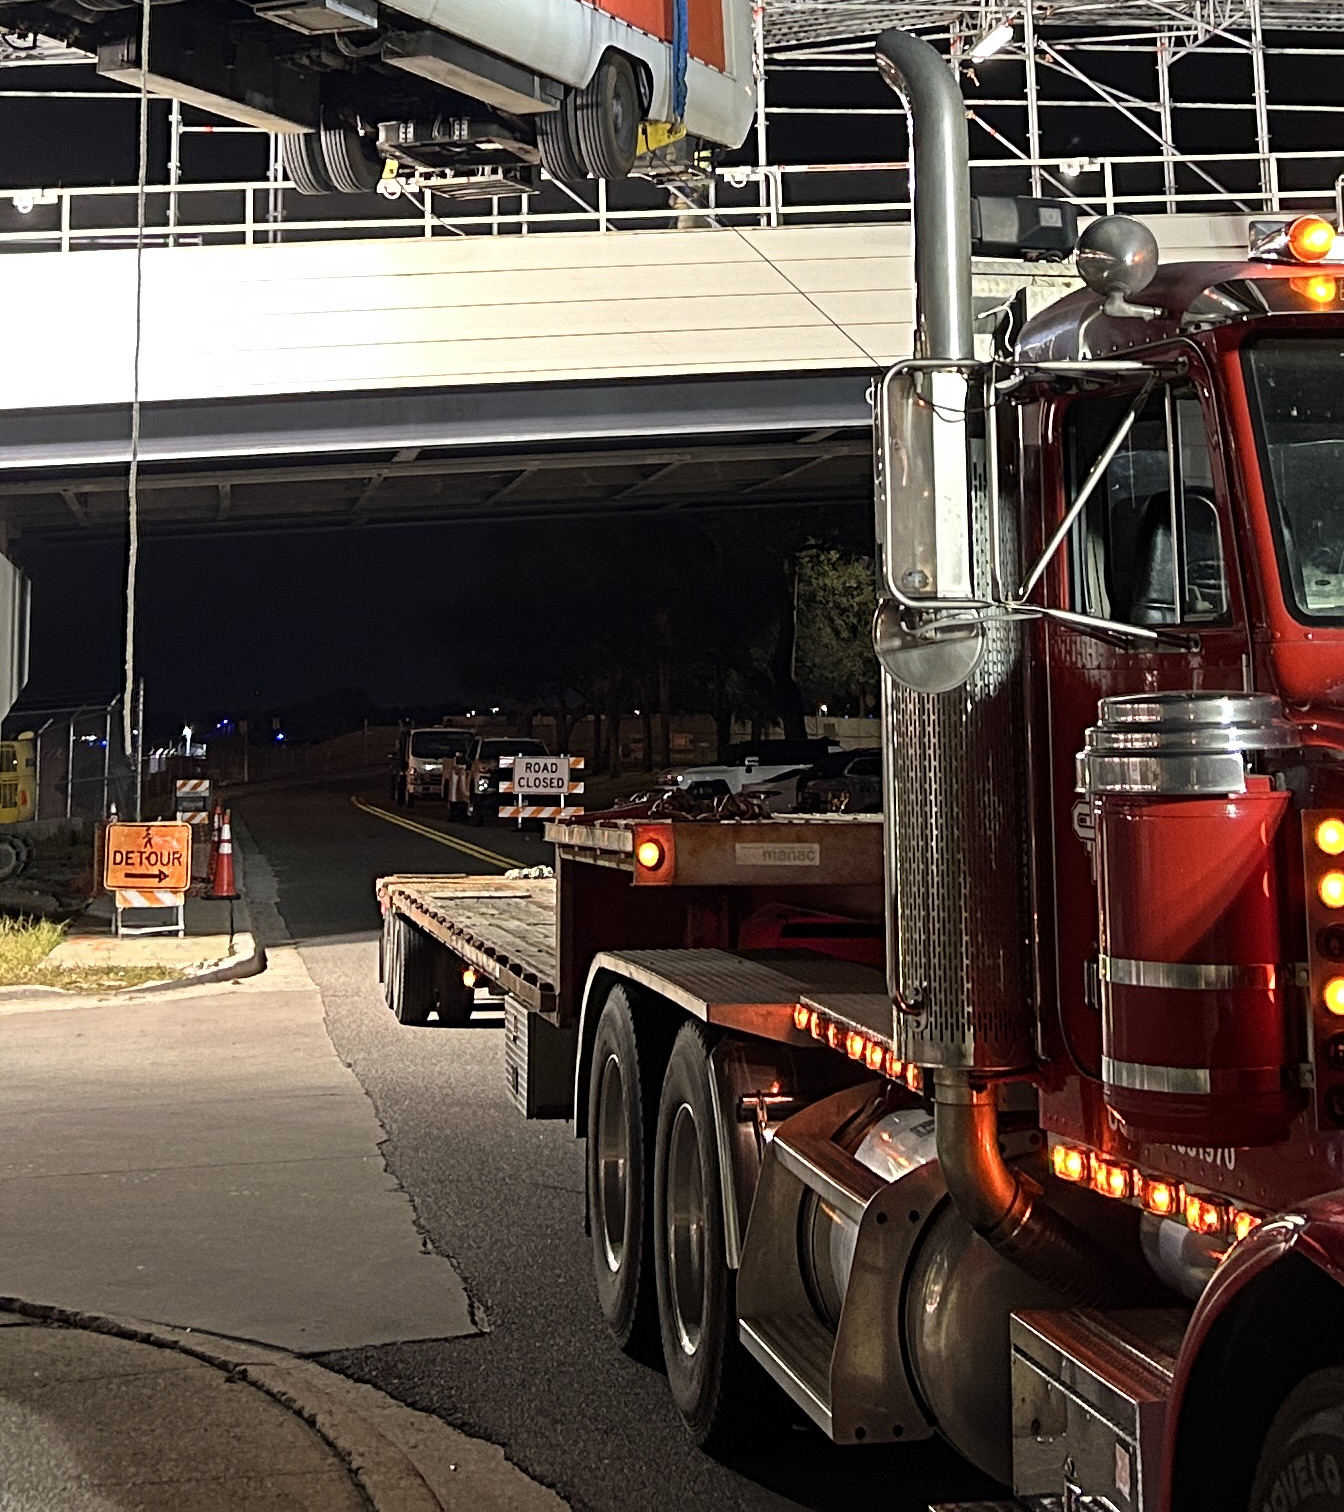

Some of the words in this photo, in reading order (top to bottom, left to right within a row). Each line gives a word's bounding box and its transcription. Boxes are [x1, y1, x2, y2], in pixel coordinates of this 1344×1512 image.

[525, 762, 558, 774] ROAD
[517, 777, 565, 789] CLOSED
[112, 850, 183, 867] DETOUR
[762, 849, 816, 862] manac
